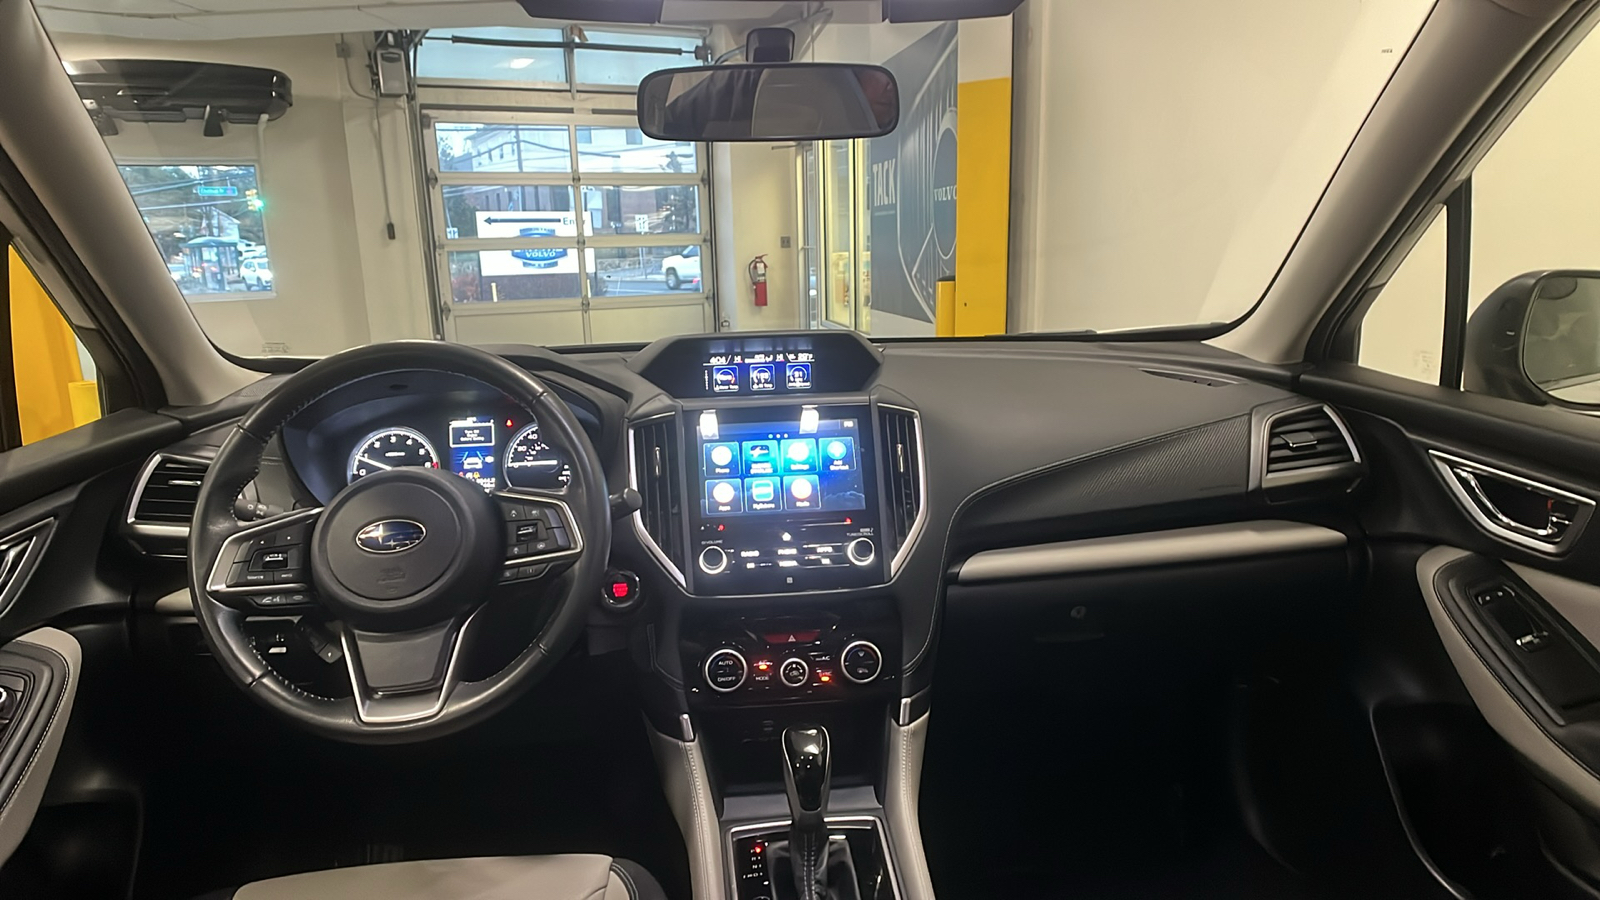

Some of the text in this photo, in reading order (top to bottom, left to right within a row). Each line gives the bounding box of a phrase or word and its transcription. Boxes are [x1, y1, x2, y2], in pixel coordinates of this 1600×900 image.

[872, 158, 896, 207] TACK
[934, 185, 957, 201] VOLVO
[359, 469, 367, 477] 0
